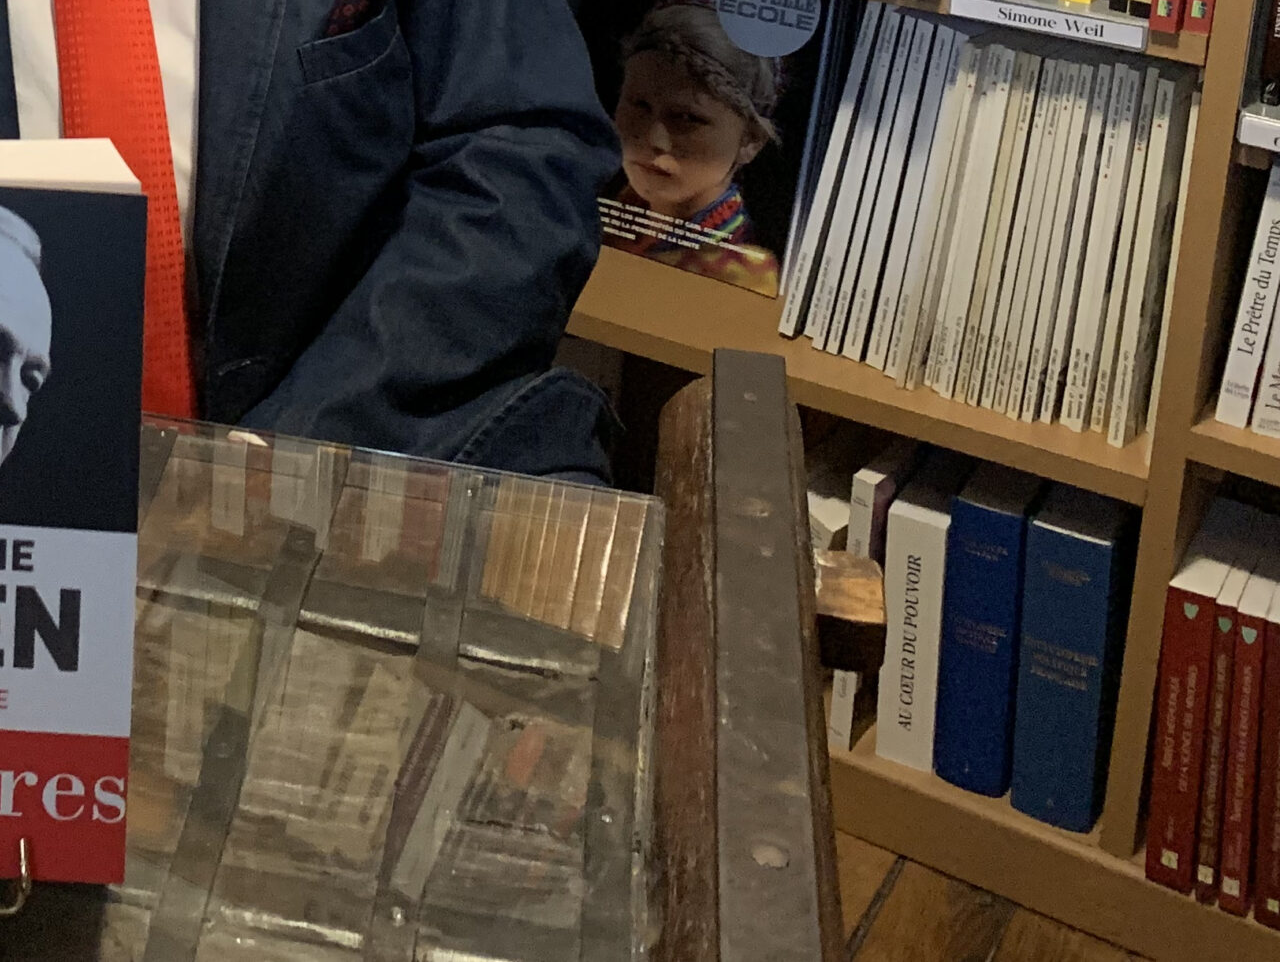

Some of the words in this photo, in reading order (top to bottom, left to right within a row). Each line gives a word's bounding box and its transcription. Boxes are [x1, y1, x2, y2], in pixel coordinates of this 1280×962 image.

[997, 7, 1057, 29] Simone
[1065, 19, 1104, 38] Weil
[1261, 219, 1280, 264] Temps
[1259, 267, 1272, 289] du
[1245, 291, 1262, 336] Prêtre
[1237, 337, 1254, 356] Le
[906, 554, 922, 629] POUVOIR
[904, 634, 917, 657] DU
[900, 658, 916, 704] CŒUR
[898, 708, 912, 731] AU
